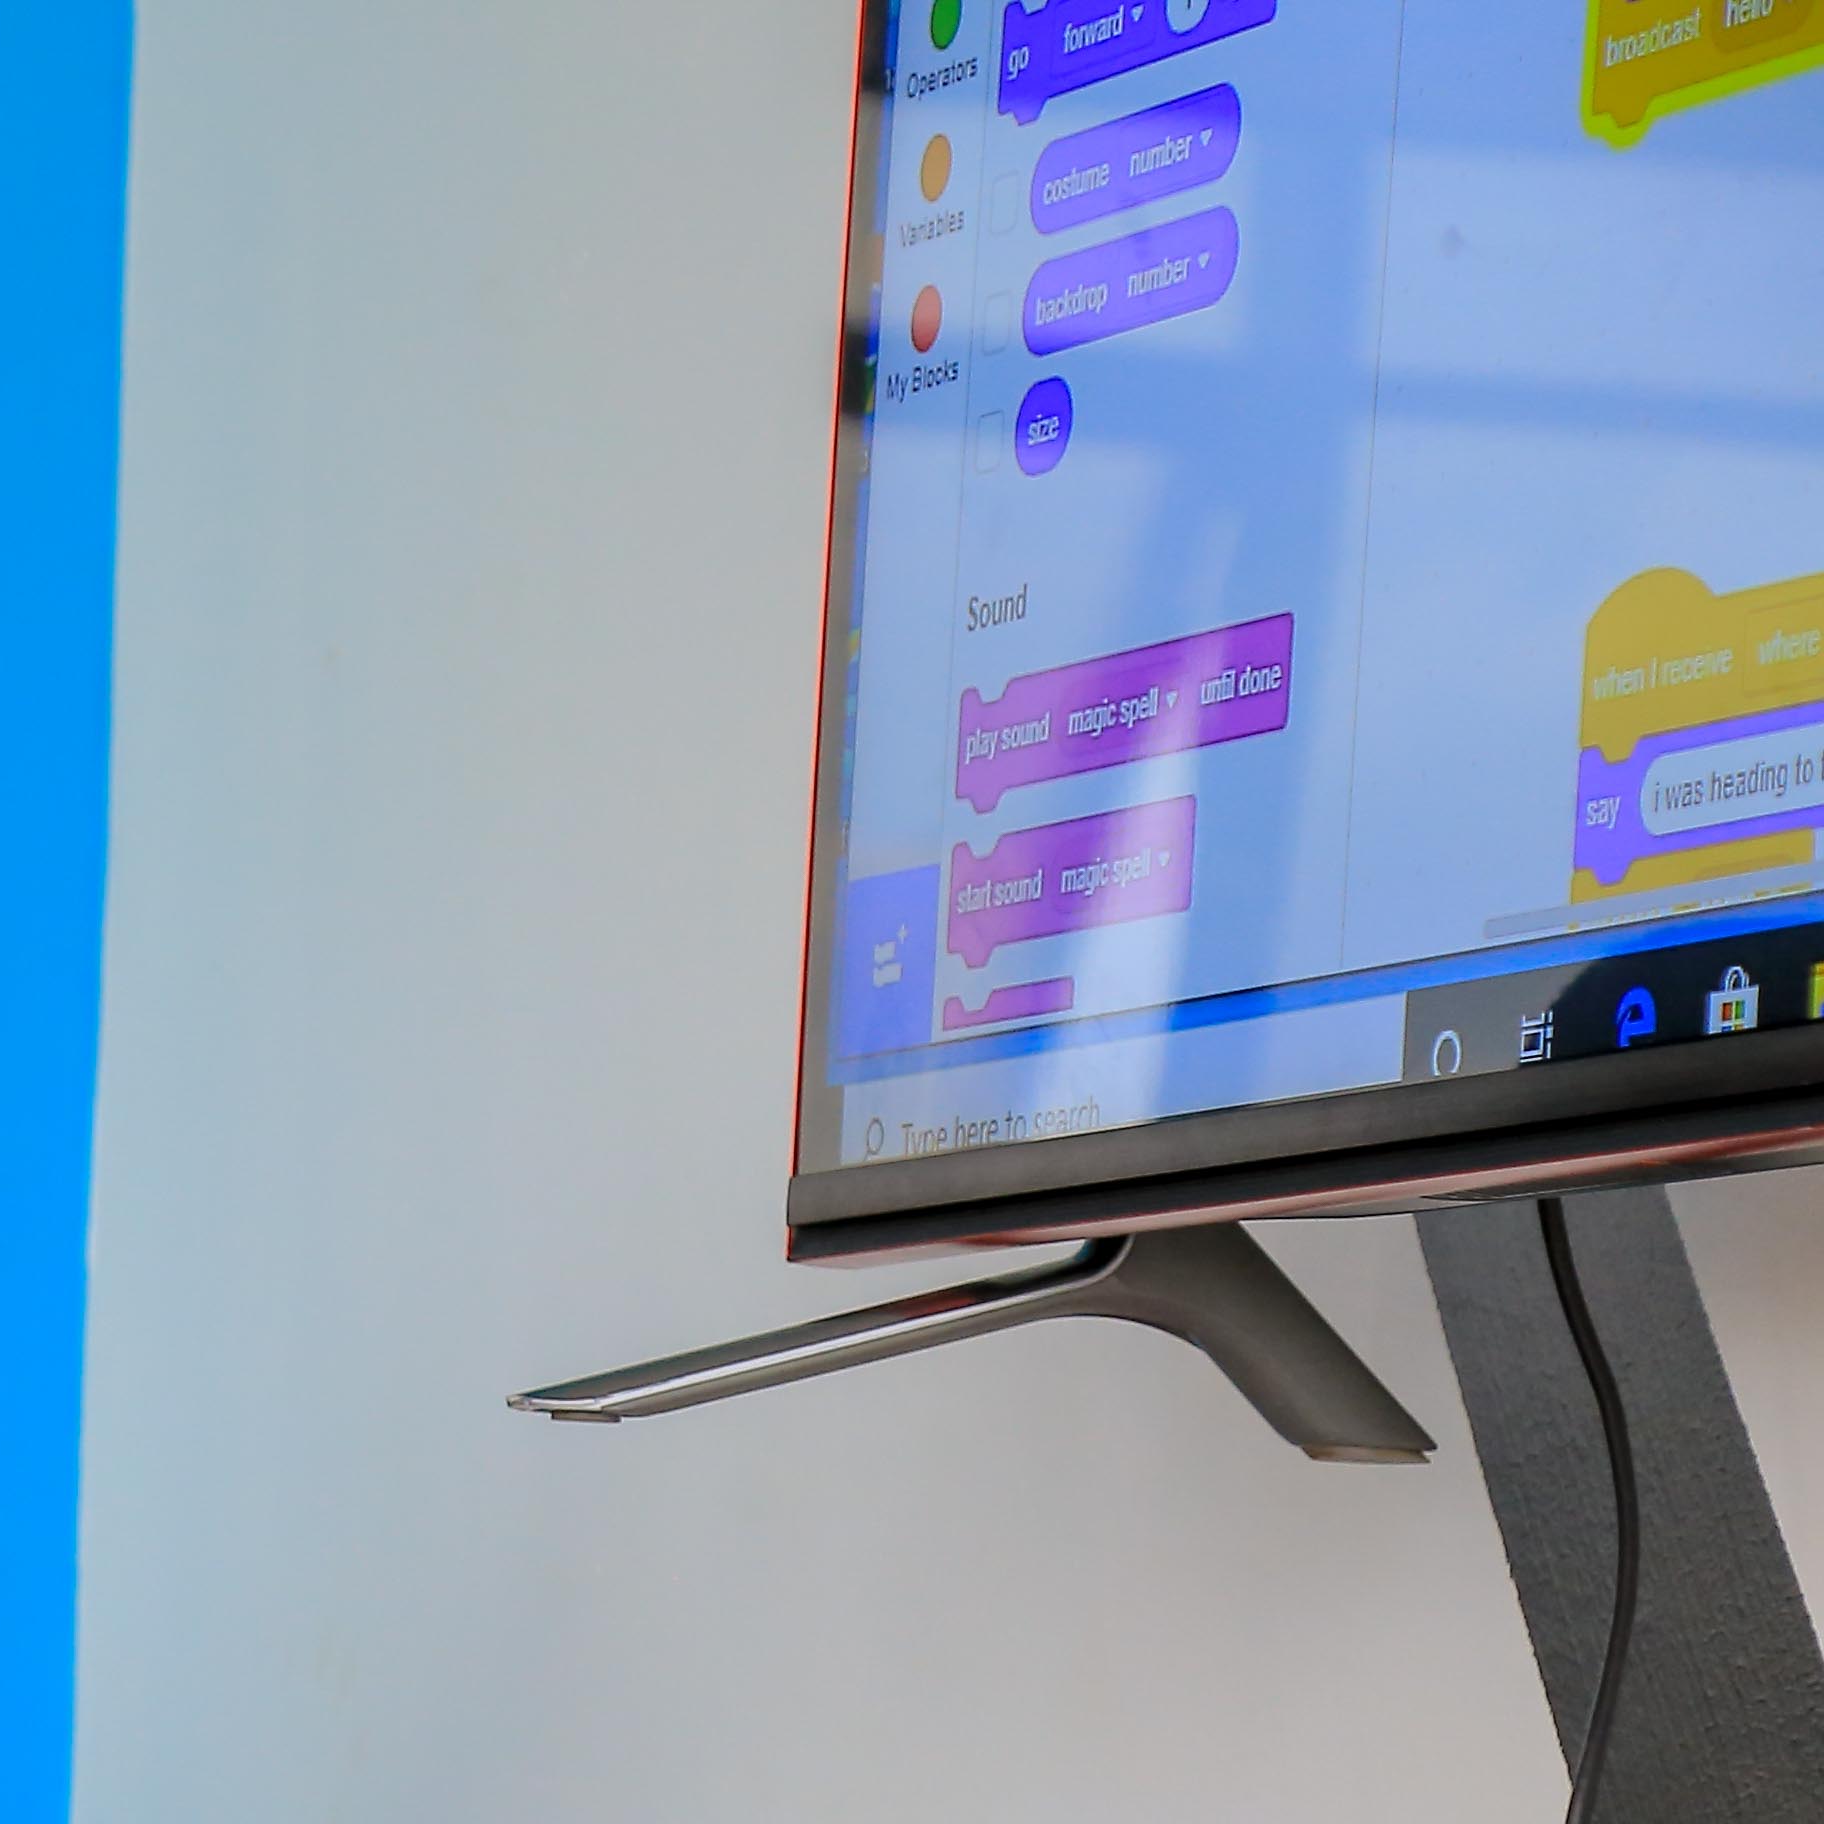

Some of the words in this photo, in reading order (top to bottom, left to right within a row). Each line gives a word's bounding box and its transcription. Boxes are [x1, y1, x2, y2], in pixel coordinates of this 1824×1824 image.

[1007, 46, 1029, 81] go
[1064, 5, 1124, 55] forward
[1605, 7, 1700, 68] broadcast
[906, 57, 978, 101] Operators
[1043, 161, 1110, 205] costume
[1129, 133, 1192, 177] number
[900, 210, 965, 247] Variables
[1035, 281, 1108, 326] backdrop
[1127, 256, 1190, 297] number
[887, 374, 908, 403] My
[912, 358, 959, 392] Blocks
[1027, 413, 1060, 446] size
[967, 584, 1028, 632] Sound
[1593, 666, 1644, 700] when
[1660, 647, 1733, 686] receive
[1758, 628, 1821, 666] where
[965, 731, 997, 765] play
[1001, 712, 1050, 751] sound
[1068, 699, 1116, 738] magic
[1120, 687, 1159, 729] spell
[1201, 668, 1236, 705] until
[1239, 662, 1283, 695] done
[1585, 795, 1621, 829] say
[1664, 778, 1705, 811] was
[1710, 761, 1788, 800] heading
[1795, 753, 1813, 785] to
[957, 884, 991, 914] start
[994, 870, 1043, 908] sound
[1060, 863, 1108, 898] magic
[1111, 849, 1150, 888] spell
[954, 1115, 999, 1148] here
[1005, 1109, 1027, 1140] to
[1034, 1095, 1101, 1135] search
